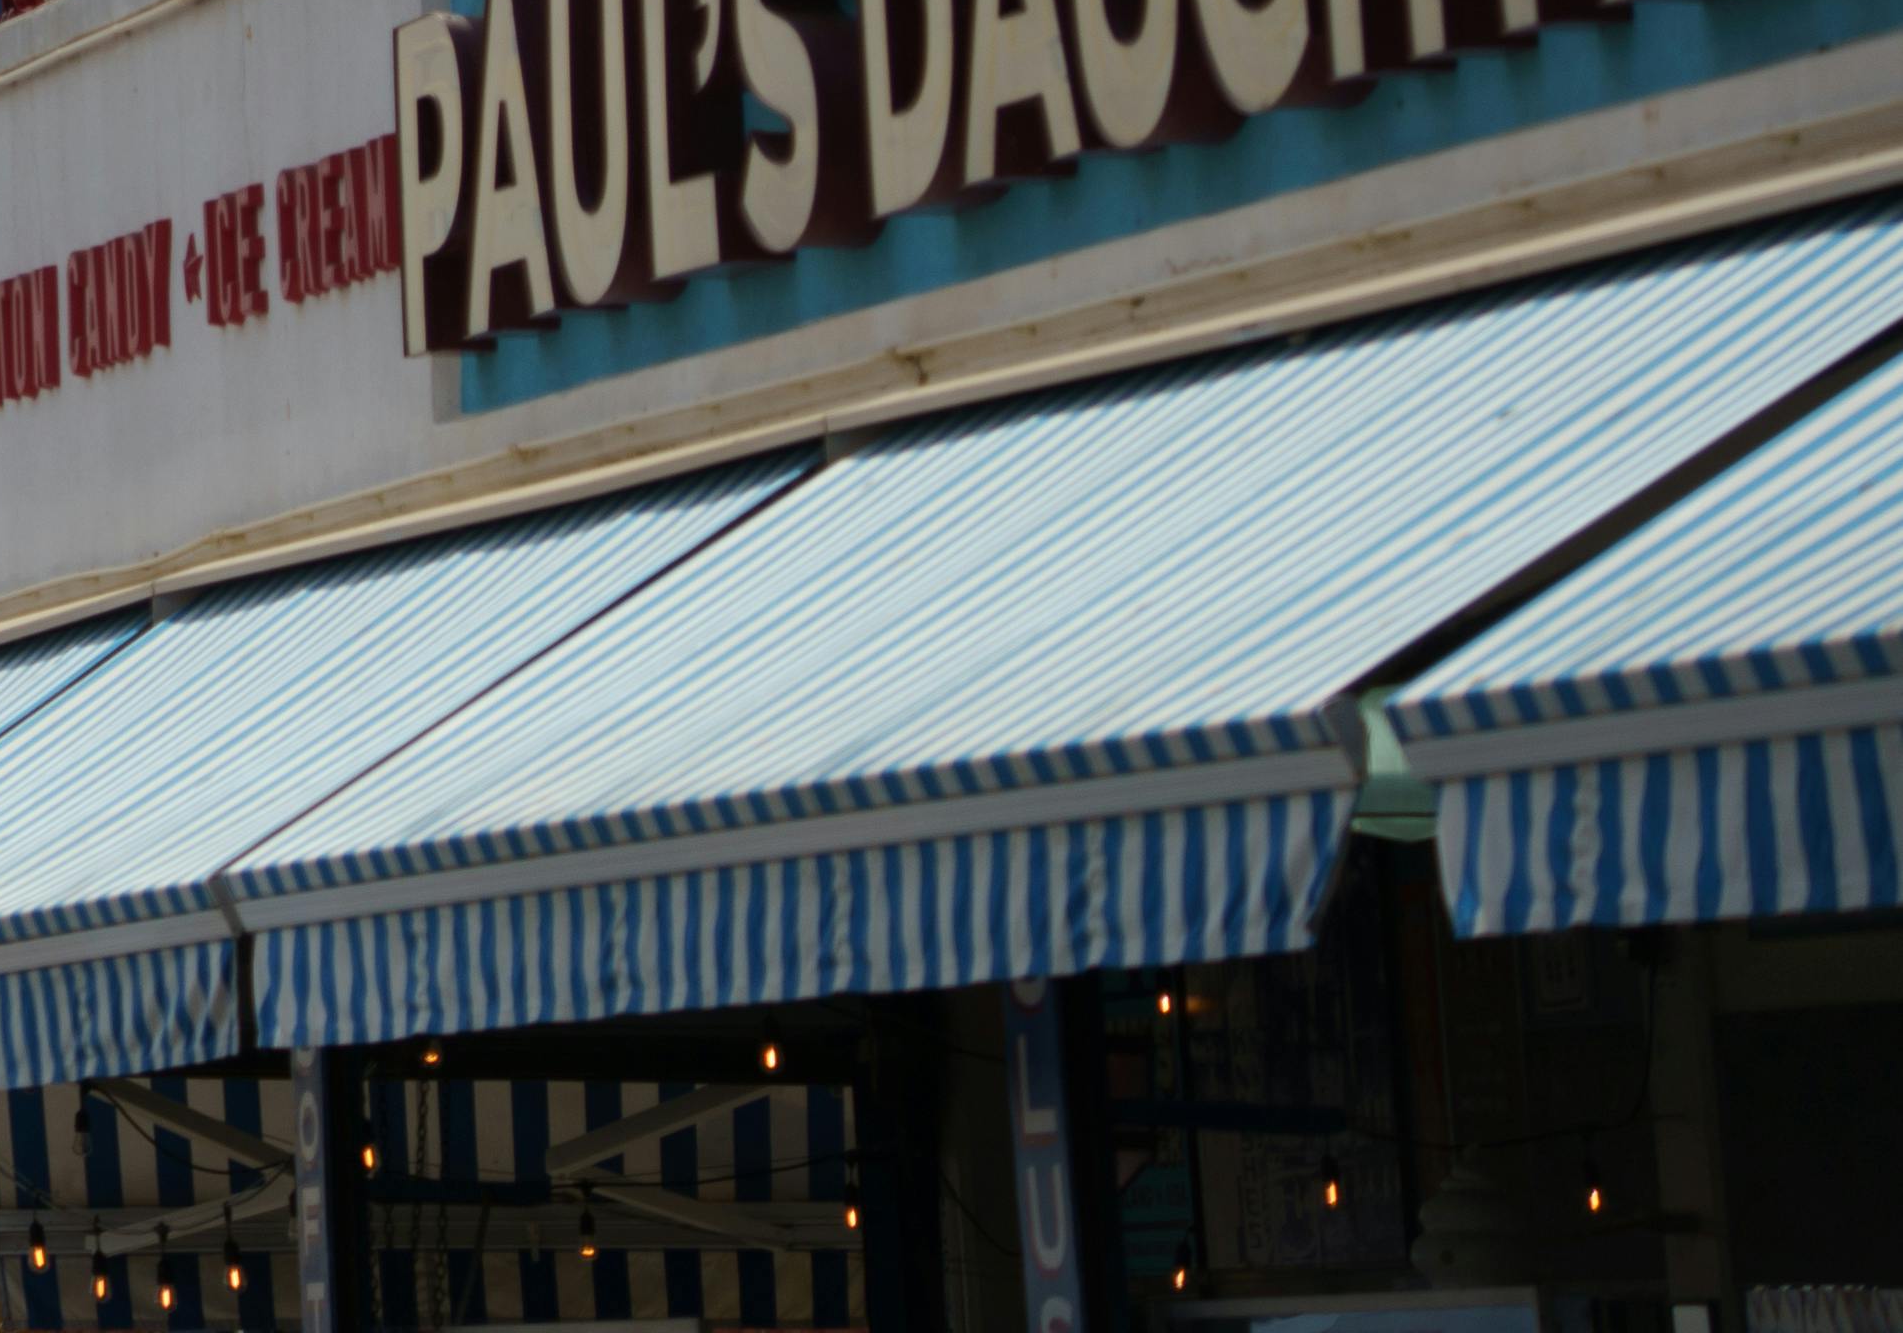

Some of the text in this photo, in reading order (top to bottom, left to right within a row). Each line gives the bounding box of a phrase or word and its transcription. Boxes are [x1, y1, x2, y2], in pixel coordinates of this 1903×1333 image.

[67, 218, 173, 379] CANDY
[202, 182, 270, 328] ICE
[275, 132, 401, 304] CREAM
